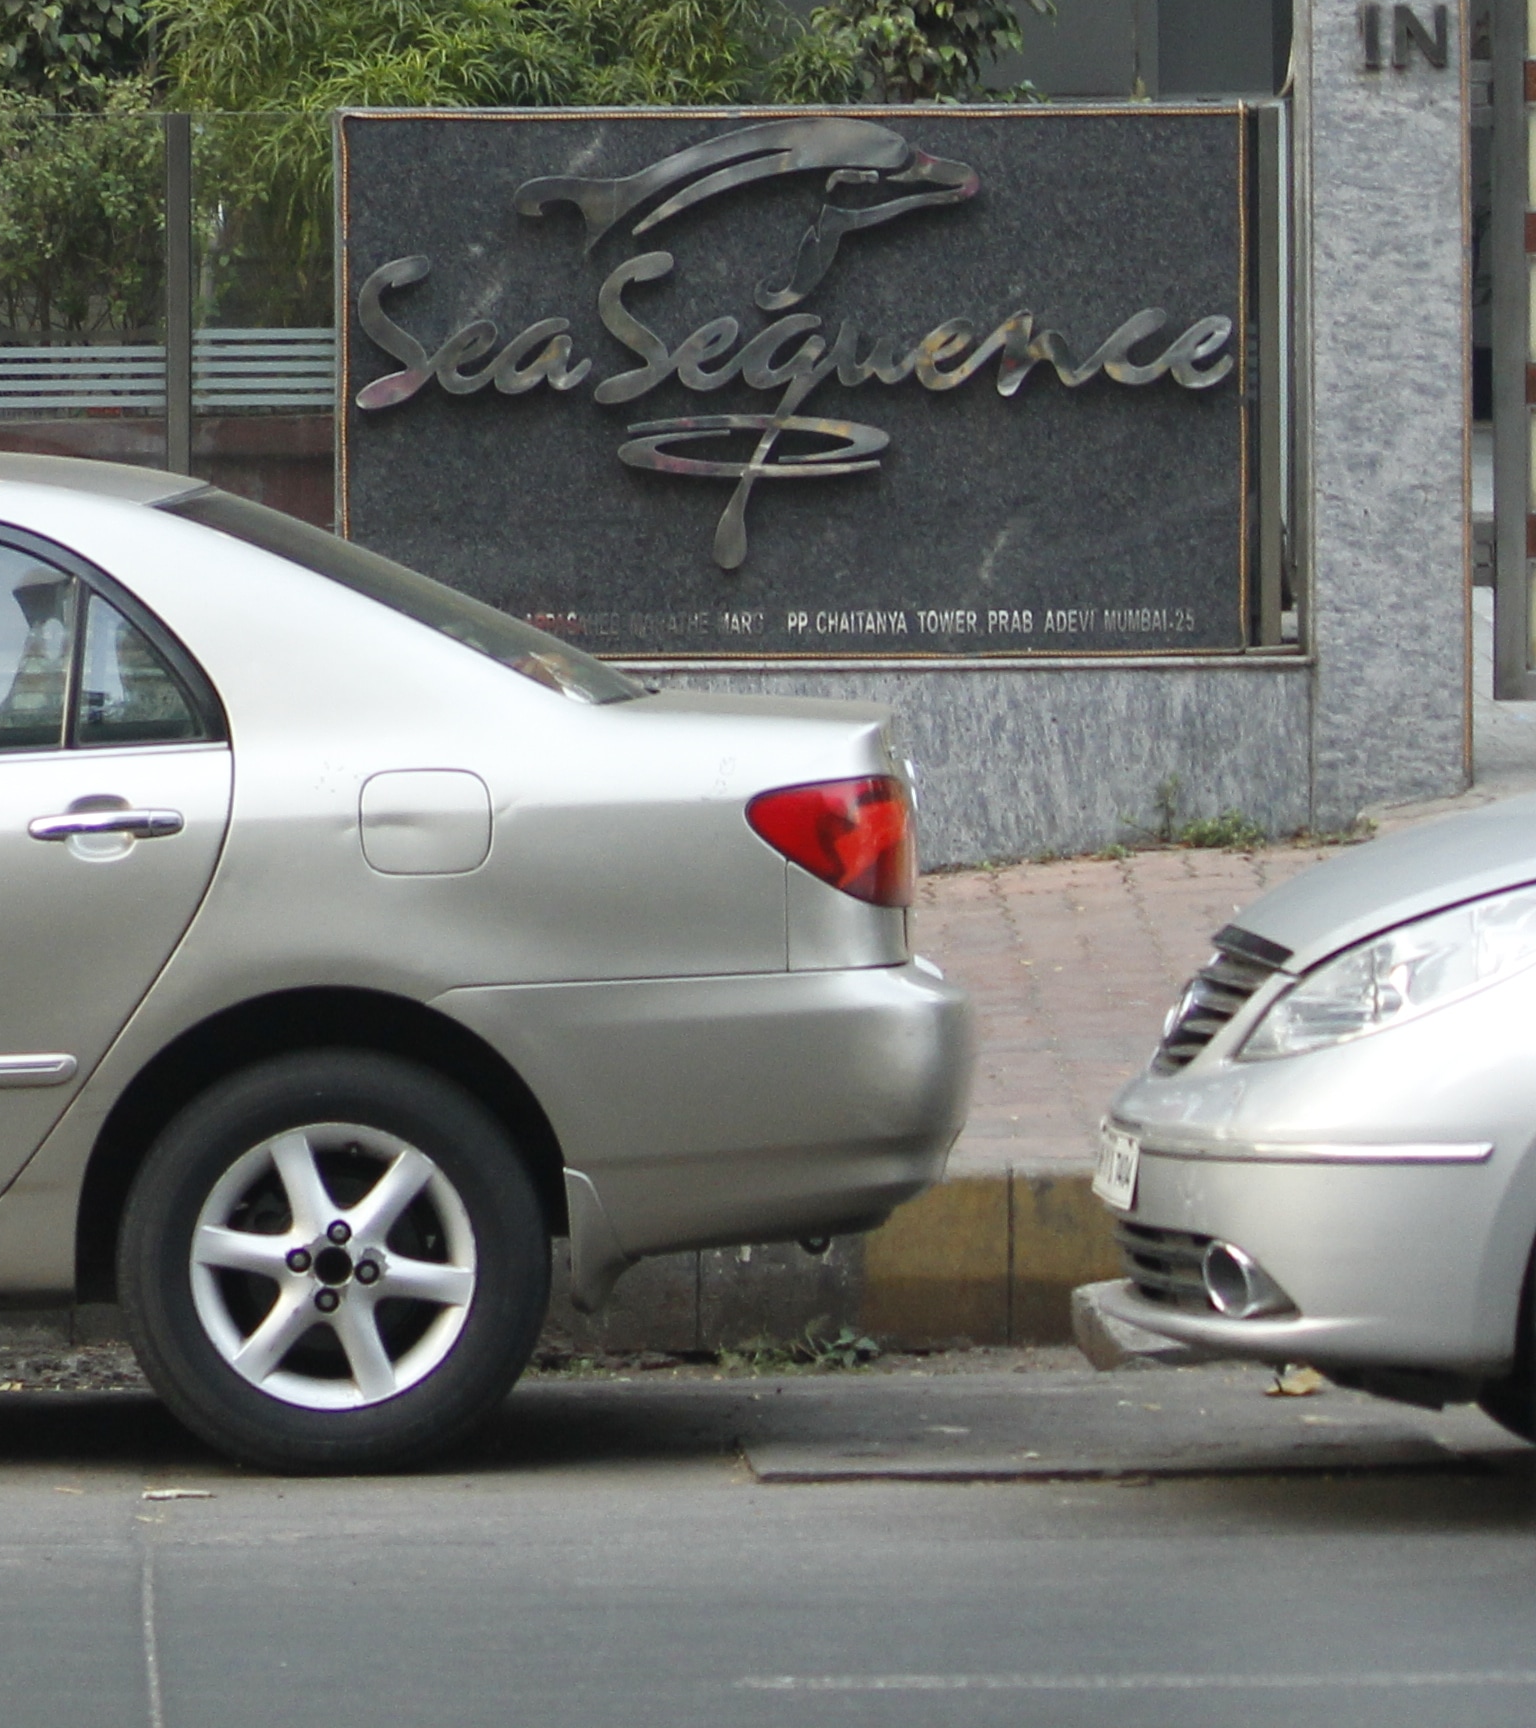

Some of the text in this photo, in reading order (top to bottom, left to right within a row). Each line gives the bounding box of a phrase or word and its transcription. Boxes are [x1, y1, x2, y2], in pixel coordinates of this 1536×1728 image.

[1365, 3, 1447, 70] IN
[355, 250, 1235, 571] Sea Sequence
[815, 611, 908, 634] CHAITANYA
[987, 609, 1034, 633] PRAB
